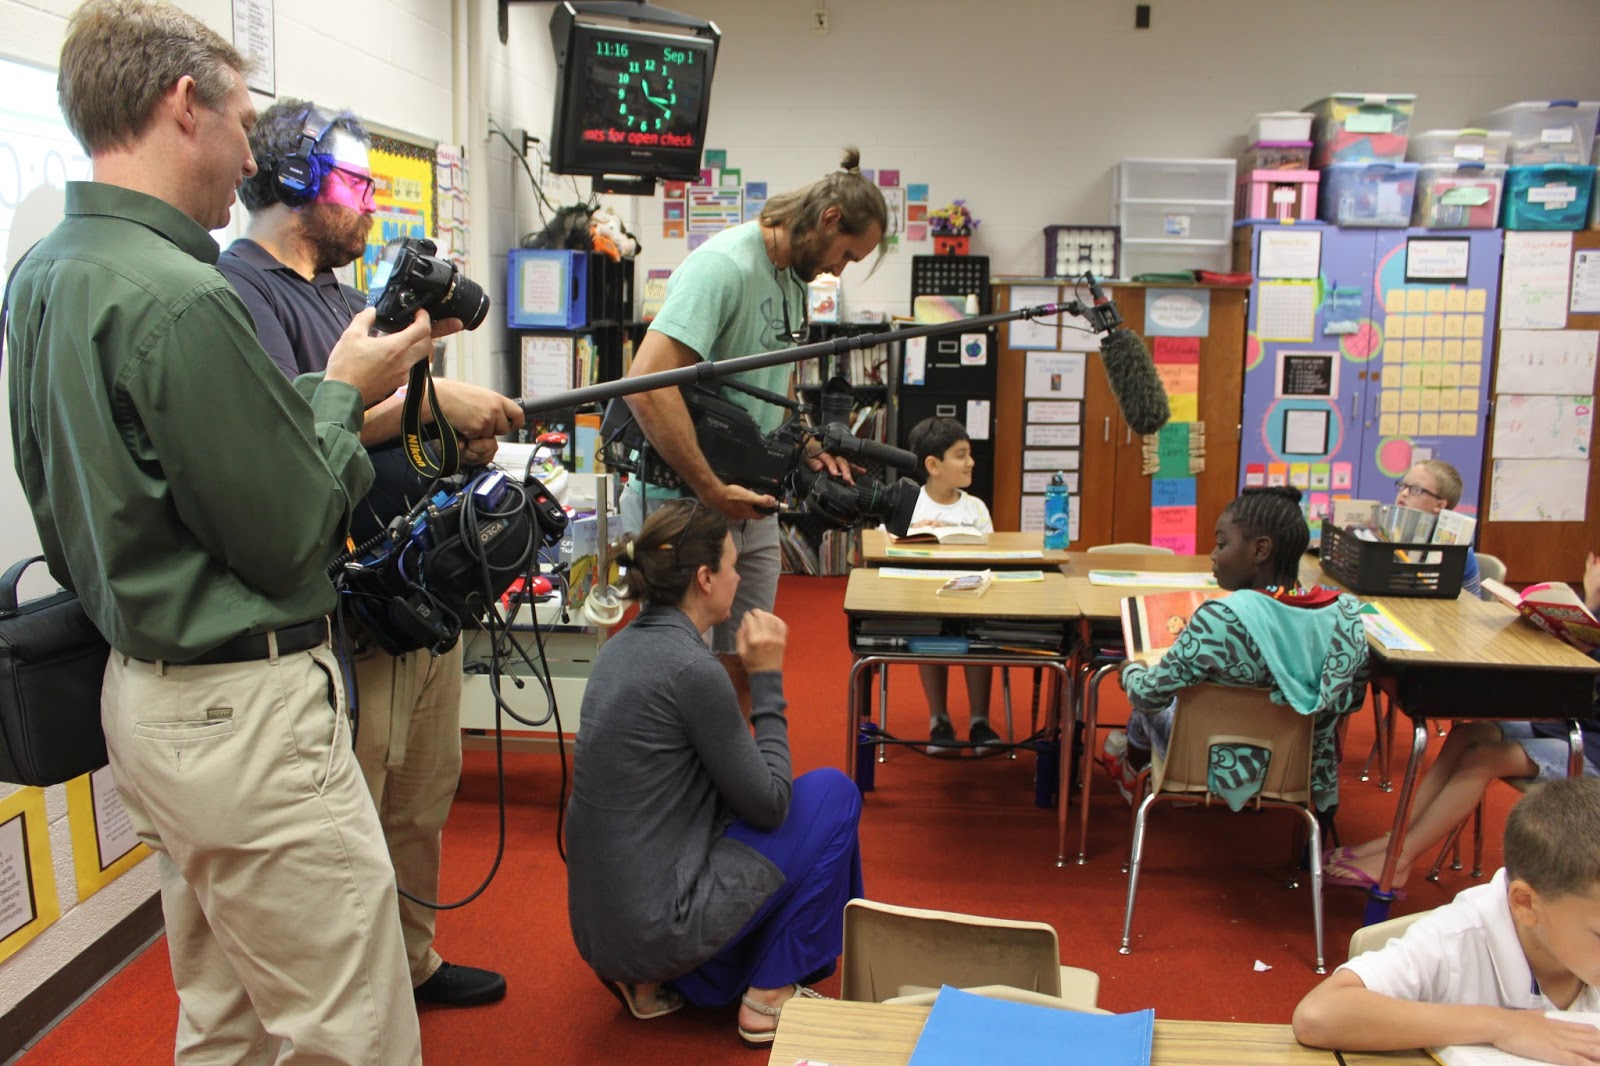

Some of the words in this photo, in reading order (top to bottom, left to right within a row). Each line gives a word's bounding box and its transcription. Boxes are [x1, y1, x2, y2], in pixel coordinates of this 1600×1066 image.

[596, 42, 630, 58] 11:16
[663, 48, 685, 65] Sep
[687, 52, 694, 65] 1
[629, 62, 641, 73] 11
[645, 60, 656, 72] 12
[661, 65, 668, 77] 1
[618, 73, 630, 85] 10
[667, 79, 674, 90] 2
[618, 88, 626, 100] 9
[670, 93, 677, 105] 3
[619, 103, 627, 115] 8
[664, 109, 672, 120] 4
[627, 115, 635, 127] 7
[640, 121, 648, 132] 6
[655, 118, 662, 130] 5
[608, 127, 625, 143] for
[627, 132, 659, 146] open
[660, 132, 694, 147] check
[407, 434, 426, 467] Nikon
[481, 523, 503, 542] ORCA
